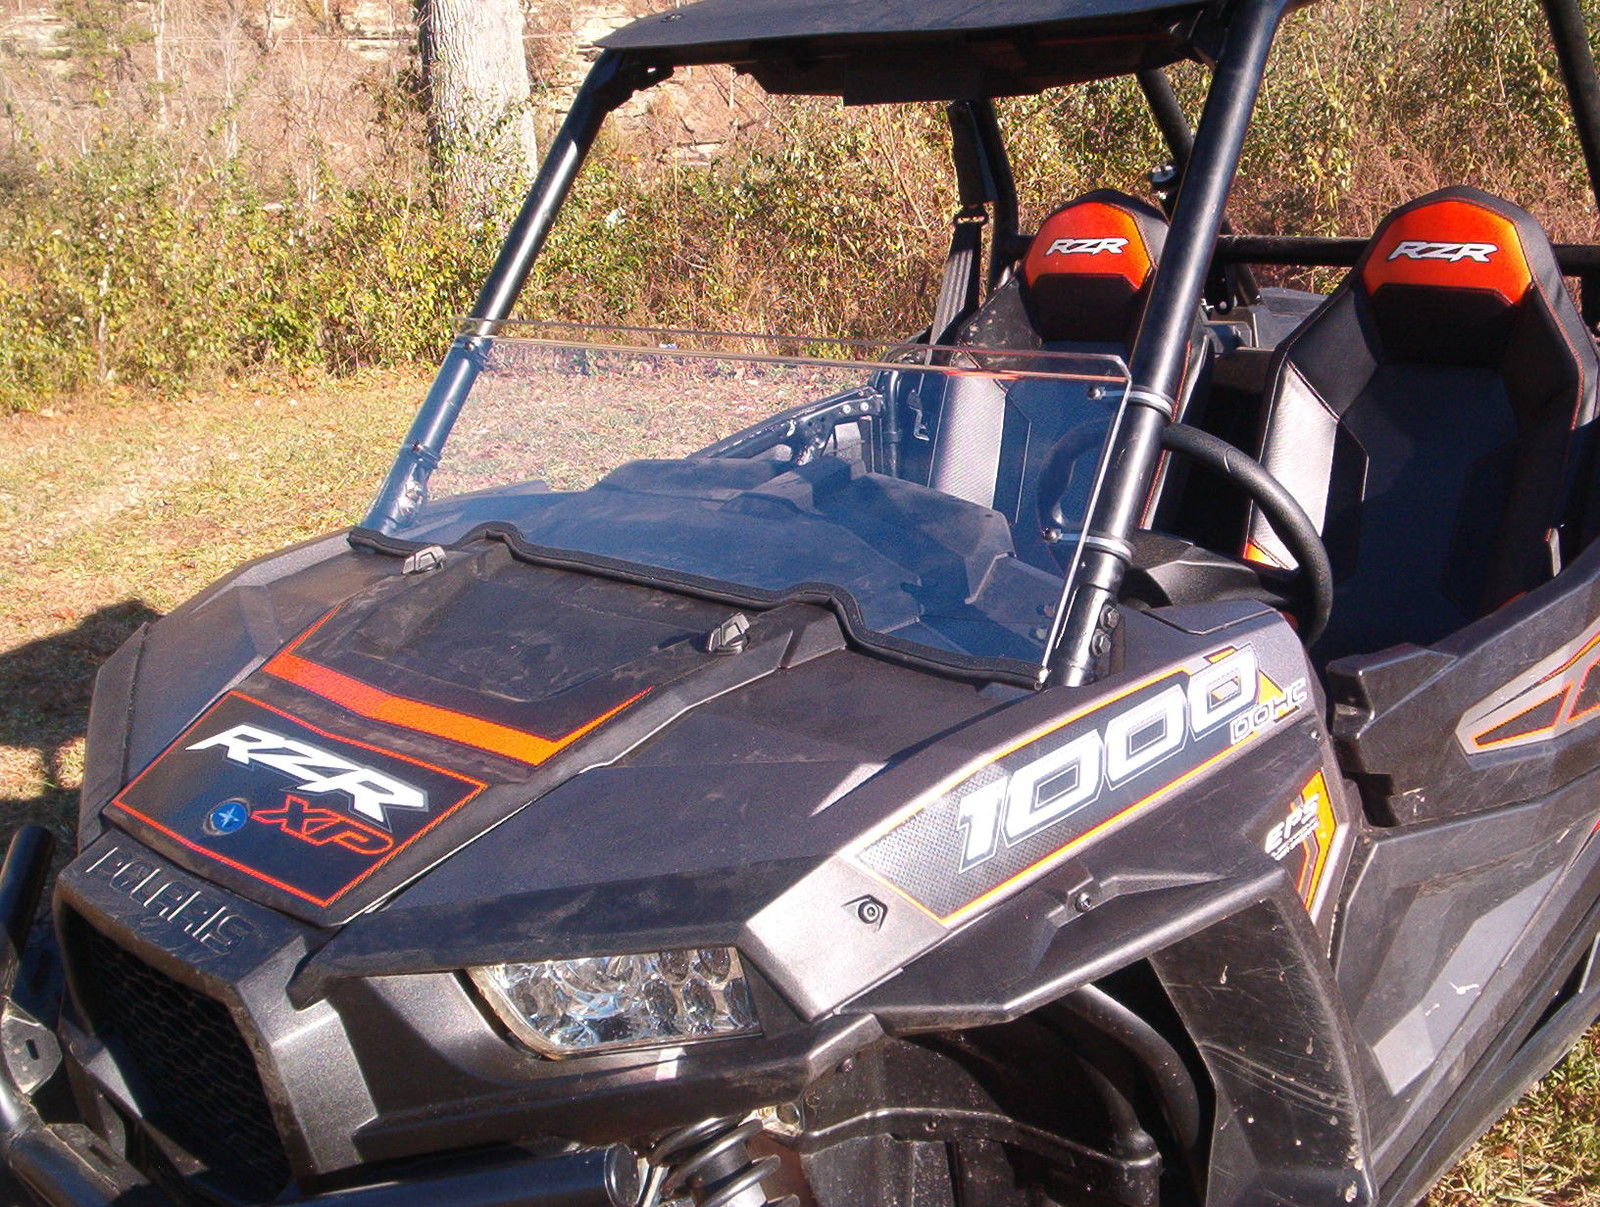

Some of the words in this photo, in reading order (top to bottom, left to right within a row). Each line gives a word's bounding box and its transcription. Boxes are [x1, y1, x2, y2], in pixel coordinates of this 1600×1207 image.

[1045, 238, 1129, 256] RZR
[1387, 241, 1498, 263] RZR
[1230, 678, 1307, 745] DOHC
[186, 724, 429, 822] RZR
[957, 644, 1259, 872] 1000
[251, 796, 394, 854] XP
[1264, 793, 1320, 854] EPS
[85, 846, 256, 956] POLARIS
